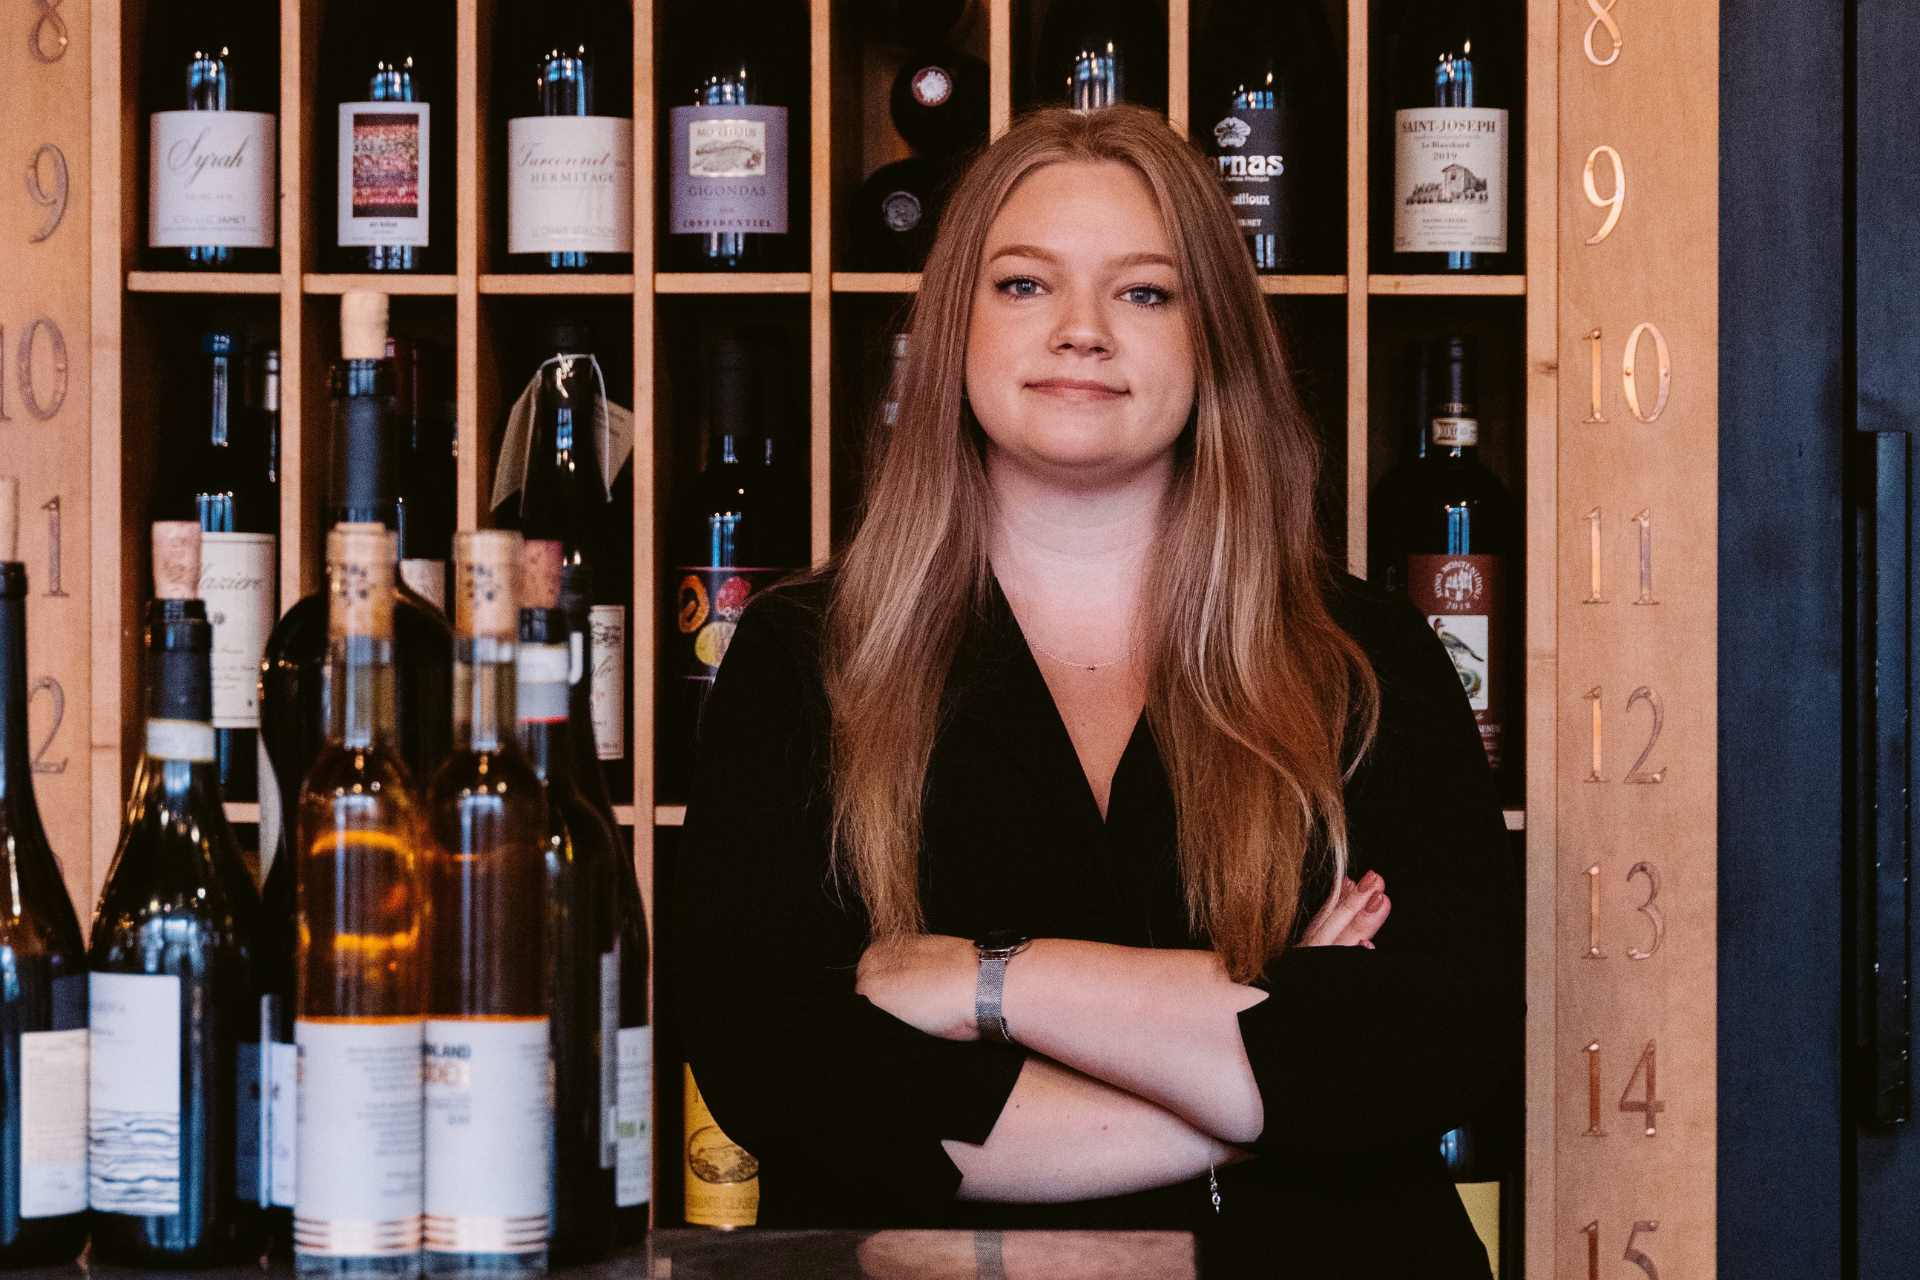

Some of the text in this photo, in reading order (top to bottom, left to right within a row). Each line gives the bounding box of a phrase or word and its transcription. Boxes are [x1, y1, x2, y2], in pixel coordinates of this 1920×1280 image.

[29, 0, 68, 64] 8
[1583, 0, 1623, 66] 8
[27, 142, 69, 244] 9
[166, 126, 250, 187] Syrah
[530, 172, 613, 184] HERMITAGE
[688, 185, 766, 197] GIGONDAS
[1218, 155, 1284, 176] rnas
[1583, 145, 1625, 246] 9
[682, 218, 771, 229] CONFIDENTIEL
[1231, 192, 1270, 206] ailloux
[1582, 321, 1671, 424] 10
[40, 495, 71, 598] 1
[1582, 506, 1660, 606] 11
[29, 675, 69, 774] 2
[1582, 686, 1667, 784] 12
[1581, 861, 1665, 960] 13
[1581, 1038, 1665, 1137] 14
[1580, 1220, 1661, 1280] 15
